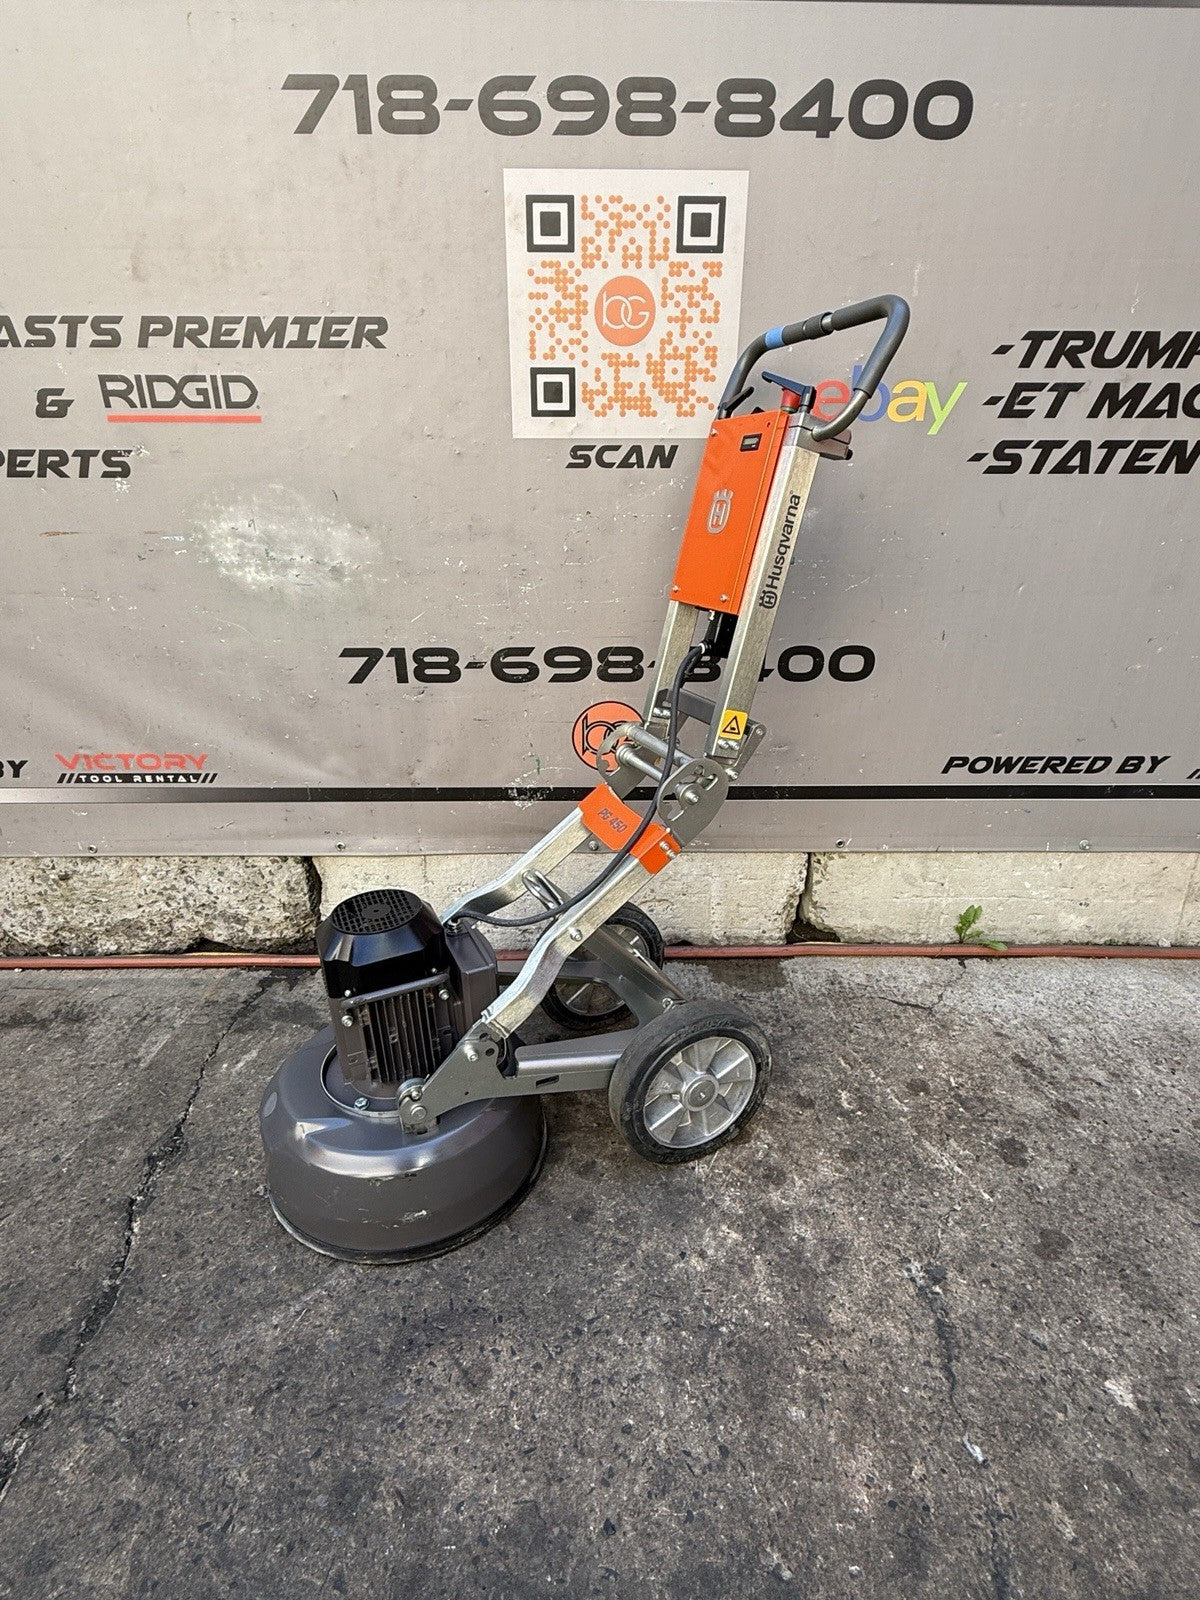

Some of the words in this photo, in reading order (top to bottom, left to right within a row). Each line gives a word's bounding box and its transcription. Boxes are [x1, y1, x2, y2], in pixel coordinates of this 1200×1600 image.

[281, 73, 974, 140] 718-698-8400
[137, 315, 389, 349] PREMIER
[35, 387, 75, 419] &
[98, 374, 259, 410] RIDGID
[982, 382, 1086, 419] -ET
[0, 449, 133, 479] ERTS
[566, 445, 679, 469] SCAN
[966, 439, 1200, 475] -STATEN
[766, 493, 801, 590] Husqvarna
[338, 645, 876, 684] 718-698800
[54, 752, 208, 771] VICTORY
[78, 774, 124, 783] TOOL
[133, 774, 199, 783] RENTAL
[940, 756, 1113, 775] POWERED
[1115, 756, 1172, 775] BY
[597, 807, 613, 820] PG
[608, 817, 628, 833] 450
